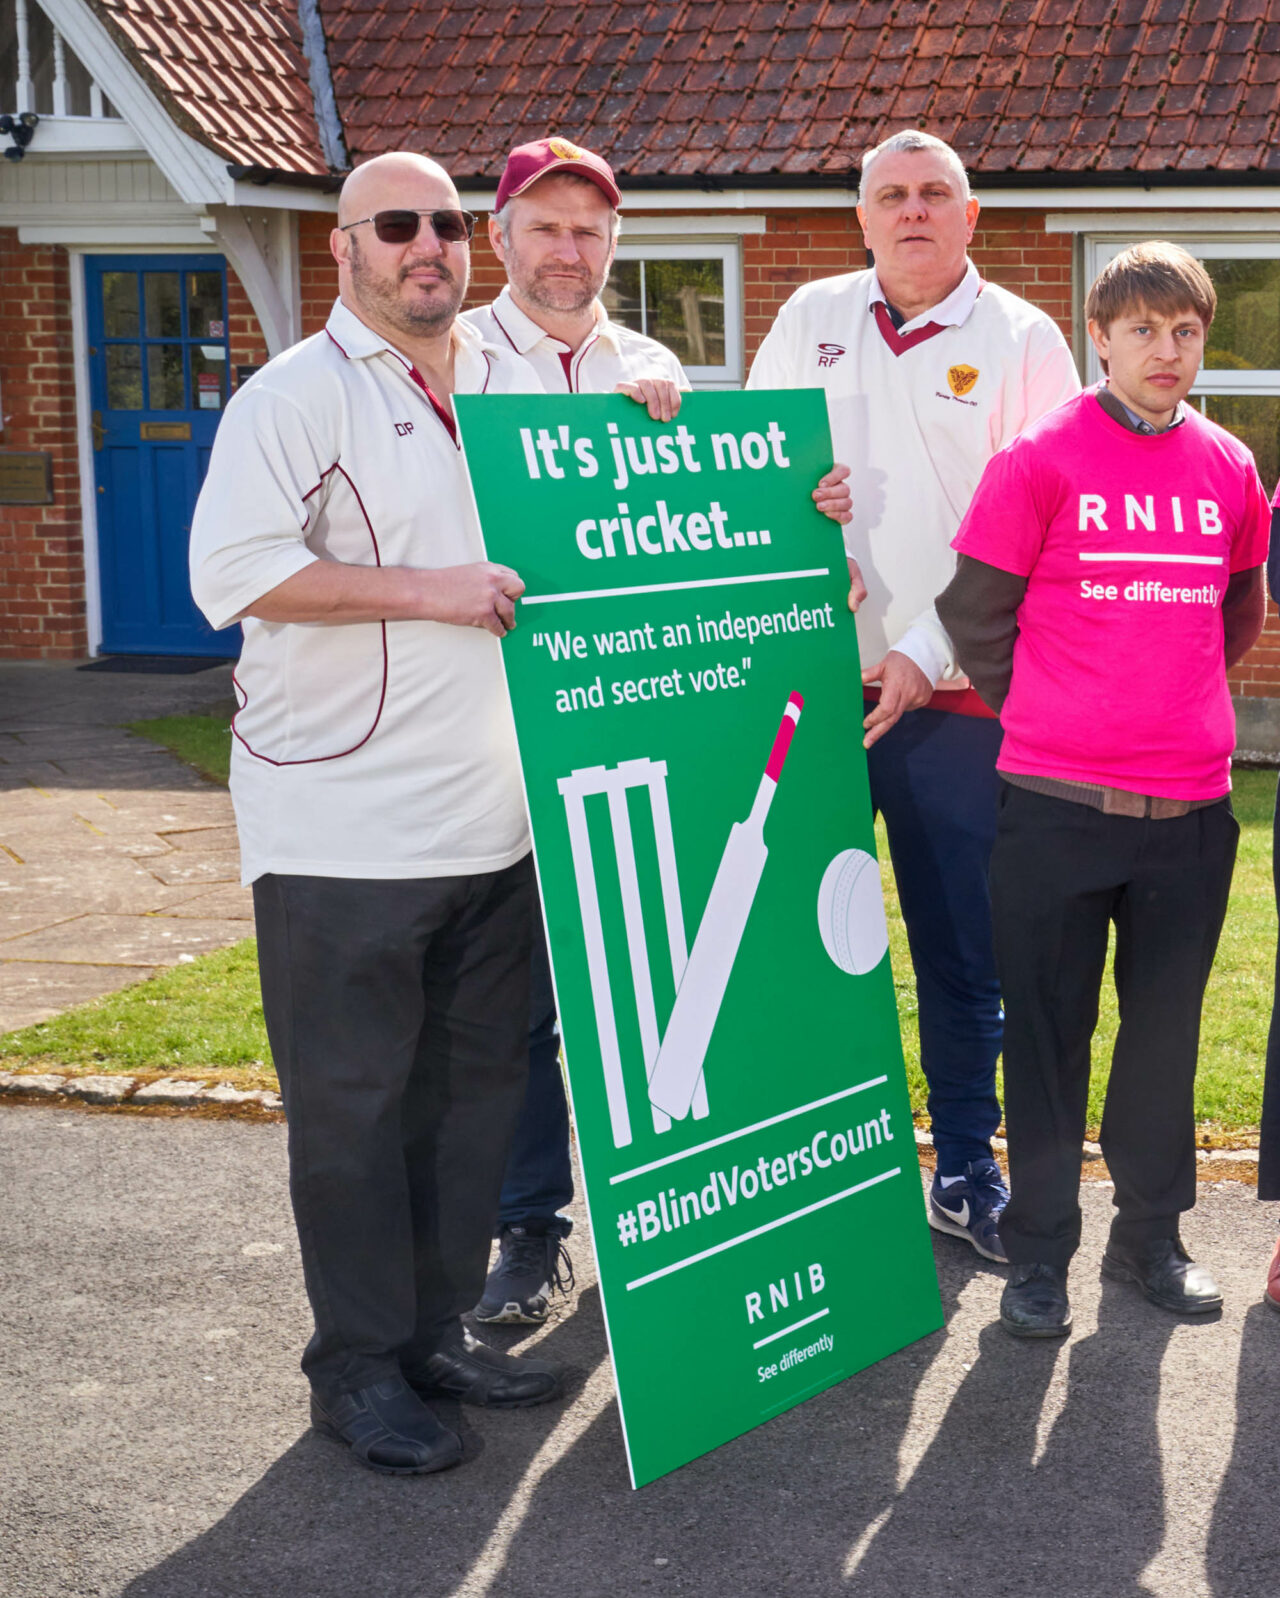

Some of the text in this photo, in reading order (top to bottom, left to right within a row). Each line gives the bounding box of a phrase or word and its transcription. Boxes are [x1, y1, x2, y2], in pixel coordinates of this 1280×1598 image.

[818, 356, 839, 368] RF
[394, 422, 414, 437] DP
[520, 422, 790, 490] It's just not
[576, 500, 771, 560] cricket...
[1079, 494, 1222, 535] RNIB
[1080, 580, 1220, 608] See differently
[593, 623, 657, 655] want
[662, 624, 691, 647] an
[696, 603, 834, 644] independent
[556, 676, 604, 712] and
[612, 669, 684, 704] secret
[617, 1109, 893, 1247] #BlindVotersCount
[745, 1263, 825, 1324] RNIB
[758, 1334, 833, 1382] See differently
